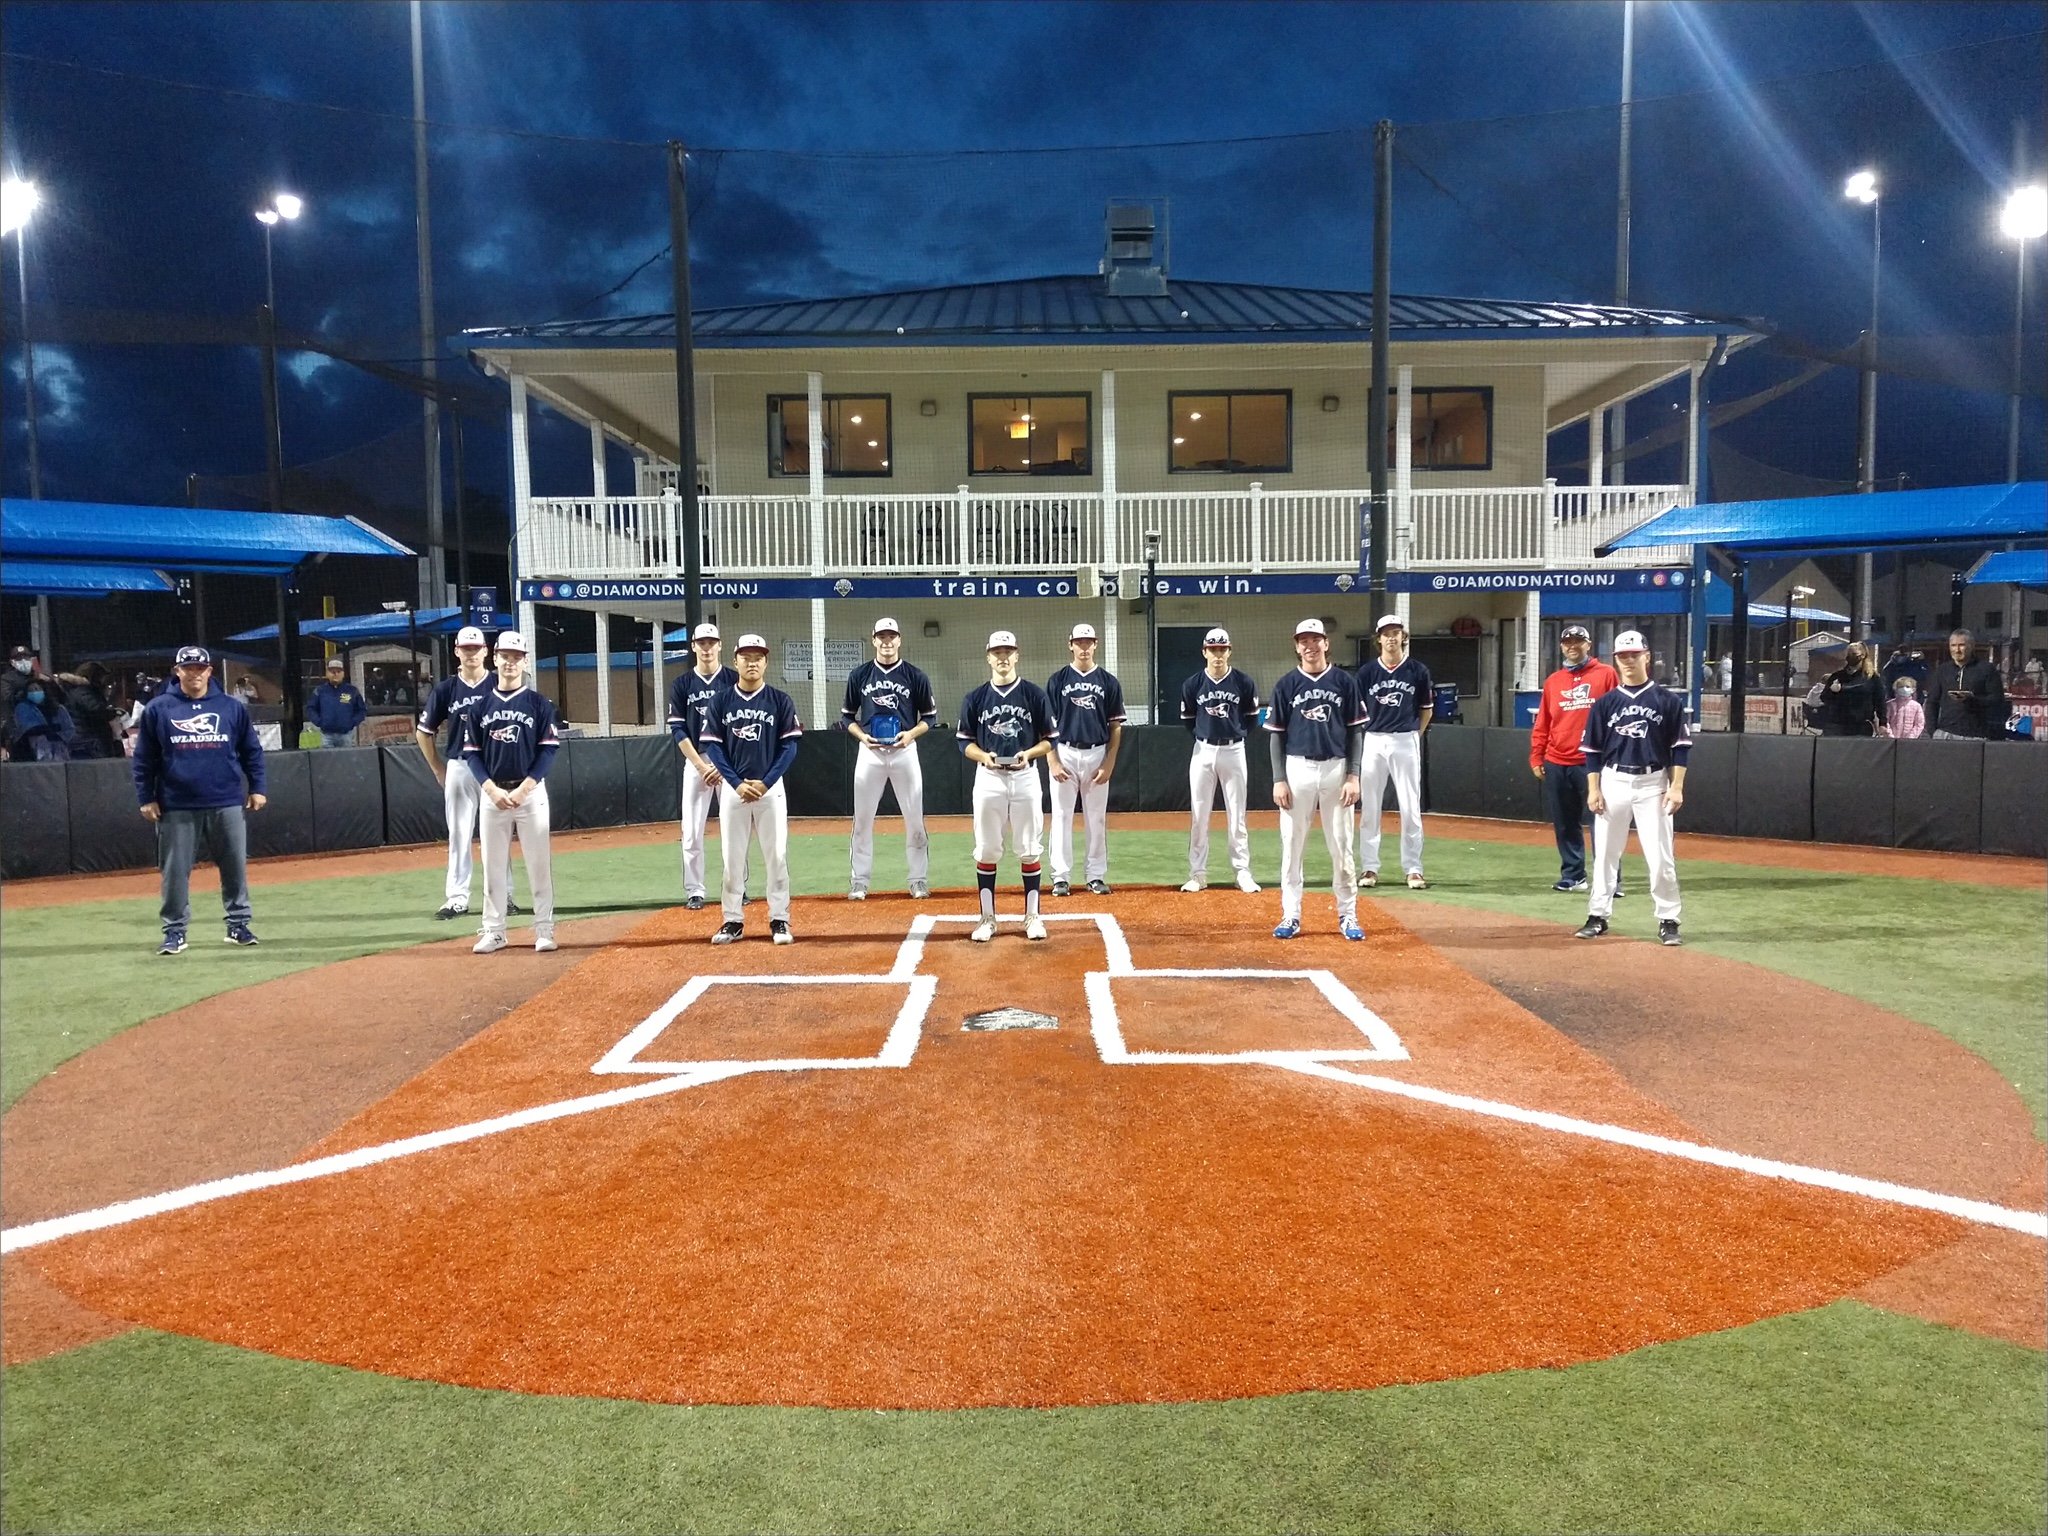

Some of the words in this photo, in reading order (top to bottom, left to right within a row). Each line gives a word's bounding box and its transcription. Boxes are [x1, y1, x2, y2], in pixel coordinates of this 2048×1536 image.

[933, 577, 1020, 596] train.
[1036, 577, 1181, 597] copte.
[1199, 575, 1263, 593] win.
[1432, 574, 1615, 589] @DIAMONDNATIONNJ
[576, 583, 758, 598] @DIAMONDNTIONNJ
[481, 613, 489, 624] 3
[861, 680, 912, 699] WLADYKA
[1062, 682, 1105, 699] WLADYKA
[1368, 679, 1416, 696] WLADYKA
[1196, 690, 1240, 706] WLADYKA
[480, 710, 535, 728] WLADYKA
[722, 708, 774, 727] WLADYKA
[978, 704, 1032, 725] WLADYKA
[169, 733, 229, 744] WLADYKA
